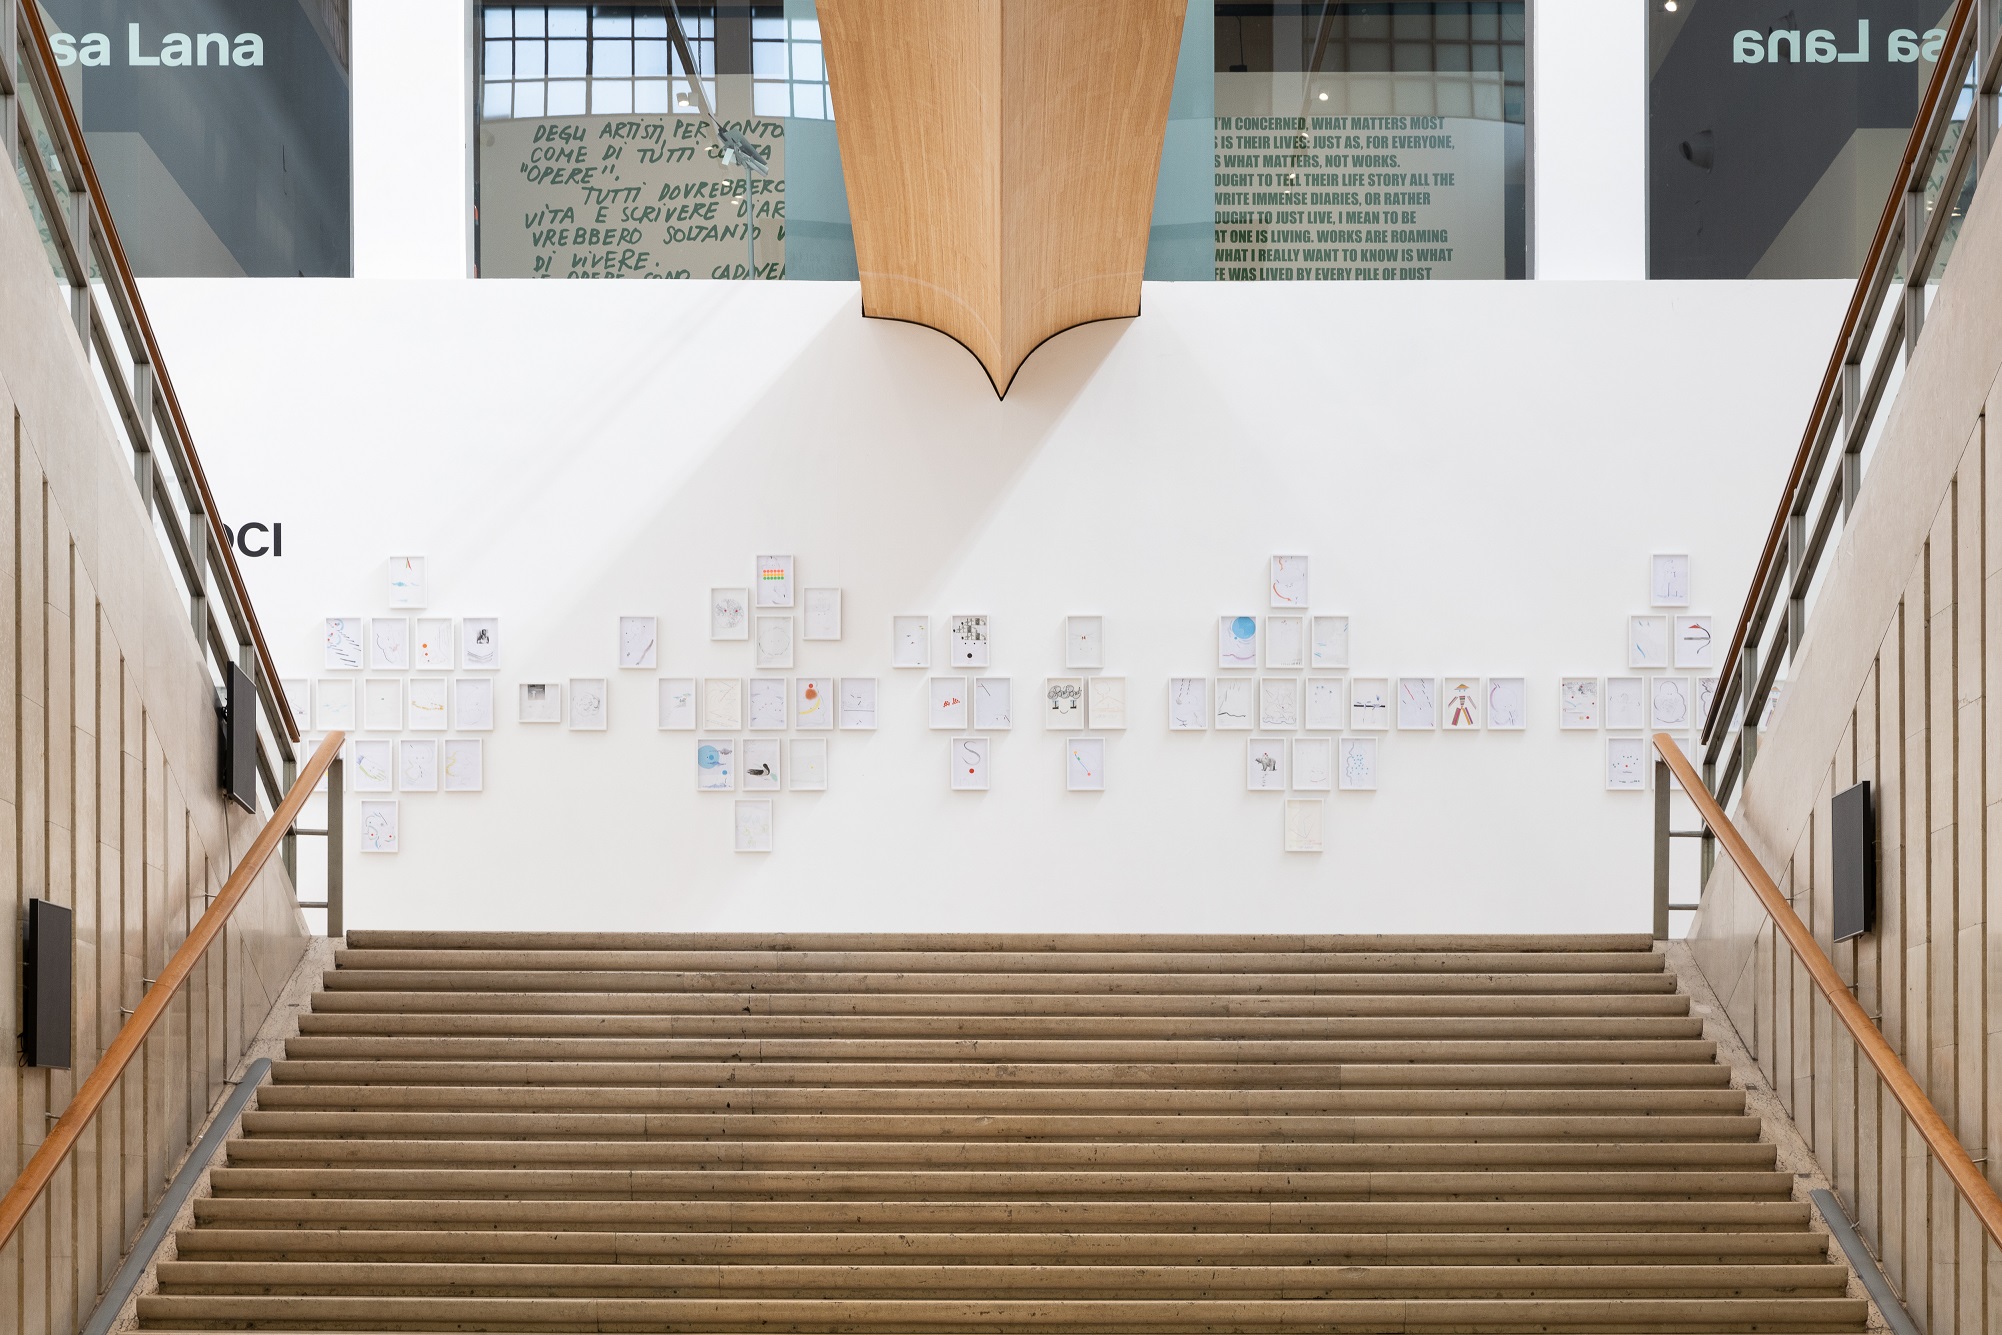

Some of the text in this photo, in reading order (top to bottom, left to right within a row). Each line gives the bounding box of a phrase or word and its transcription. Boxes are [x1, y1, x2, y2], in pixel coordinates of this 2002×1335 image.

[49, 22, 264, 67] sa Lana
[673, 119, 710, 140] PER
[1215, 117, 1445, 132] I'M CONCERNED, WHAT MATTERS MOST
[1221, 136, 1233, 149] IS
[1236, 136, 1270, 149] THEIR
[1273, 136, 1310, 149] LIVES:
[1313, 136, 1342, 149] JUST
[1344, 136, 1363, 150] AS,
[1366, 136, 1389, 149] FOR
[1391, 136, 1455, 150] EVERYONE,
[530, 146, 588, 163] COME
[1223, 155, 1260, 168] WHAT
[1262, 155, 1322, 169] MATTERS,
[1325, 155, 1349, 168] NOT
[1352, 155, 1401, 168] WORKS.
[1215, 173, 1455, 187] OUGHT TO TELL THEIR LIFE STORY ALL THE
[1252, 192, 1308, 205] IMMENSE
[1310, 192, 1362, 206] DIARIES,
[1364, 192, 1381, 205] OR
[1384, 192, 1431, 205] RATHER
[595, 206, 610, 223] E
[1215, 211, 1417, 225] OUGHT TO JUST LIVE, I MEAN TO BE
[532, 227, 643, 247] VREBBERO
[663, 223, 762, 245] SOLTANTO
[1230, 229, 1253, 243] ONE
[1255, 229, 1268, 243] IS
[1270, 229, 1314, 243] LIVING.
[1316, 229, 1363, 243] WORKS
[1365, 229, 1388, 243] ARE
[1391, 229, 1448, 243] ROAMING
[1215, 248, 1454, 262] WHAT I REALLY WANT TO KNOW IS WHAT
[1228, 267, 1257, 281] WAS
[1259, 267, 1294, 281] LIVED
[1296, 267, 1312, 281] BY
[1315, 267, 1353, 281] EVERY
[1354, 267, 1380, 281] PILE
[1382, 267, 1397, 281] OF
[1399, 267, 1433, 281] DUST
